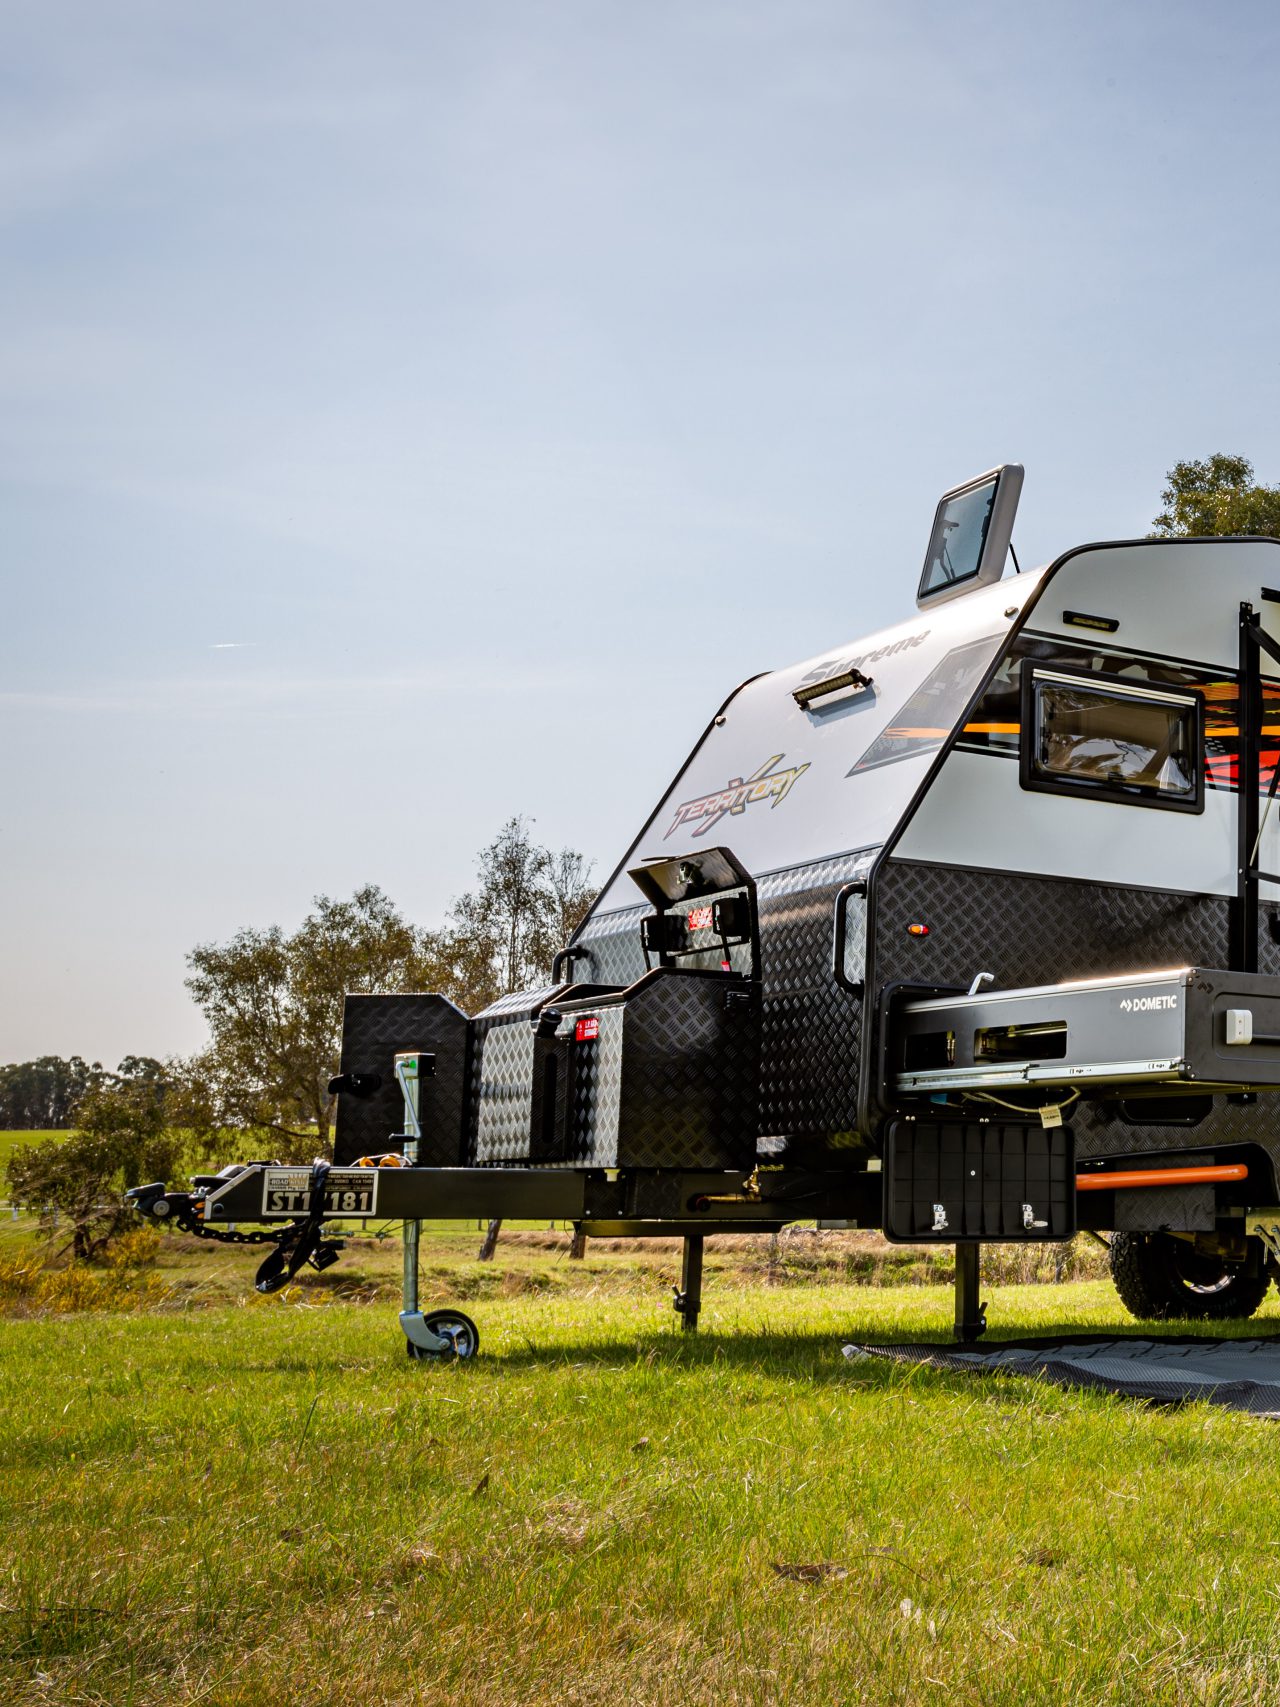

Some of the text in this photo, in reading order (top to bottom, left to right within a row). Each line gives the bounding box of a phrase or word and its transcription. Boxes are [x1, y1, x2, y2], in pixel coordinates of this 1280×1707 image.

[663, 753, 812, 841] TERRITORY
[1133, 994, 1177, 1012] DOMETIC
[271, 1191, 369, 1211] ST1181
